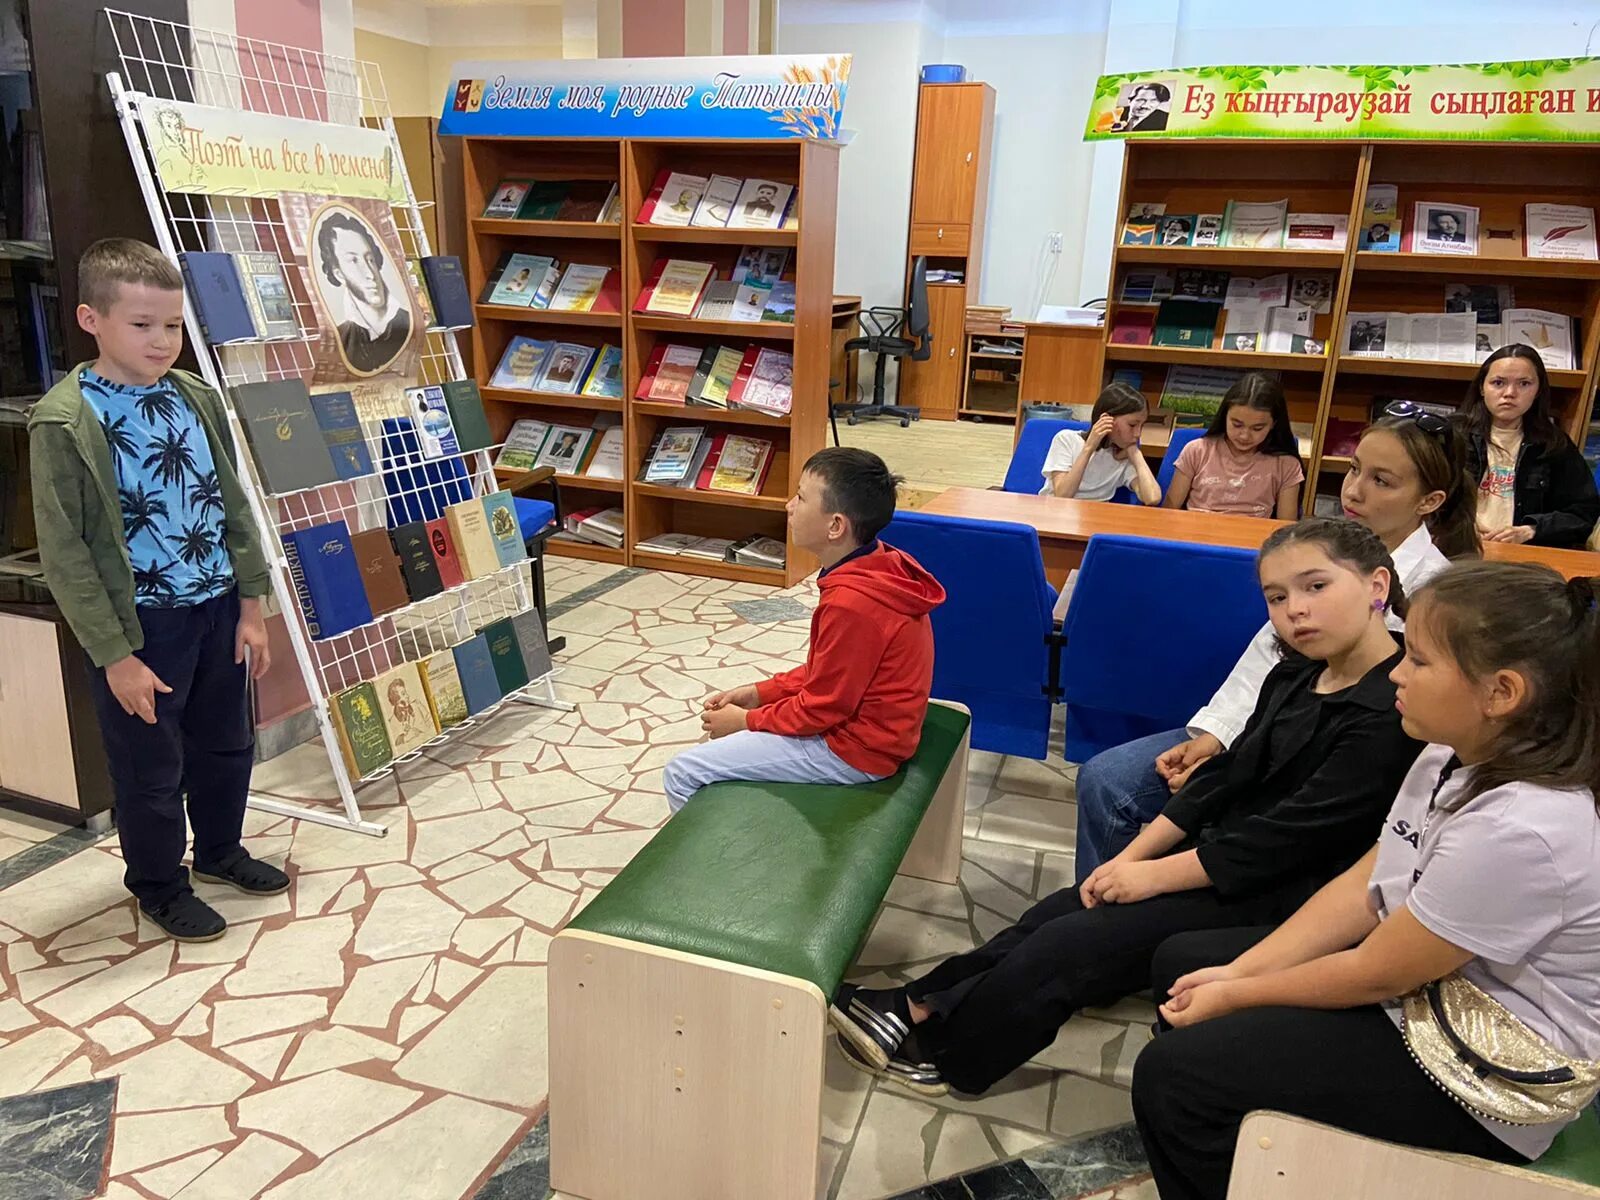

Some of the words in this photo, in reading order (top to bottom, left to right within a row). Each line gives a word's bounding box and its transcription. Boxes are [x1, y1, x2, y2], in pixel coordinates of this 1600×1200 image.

[486, 75, 552, 108] Земля
[559, 85, 605, 111] моя,
[611, 85, 694, 117] родные
[181, 127, 245, 168] Поэт
[248, 146, 277, 171] на
[281, 139, 309, 174] все
